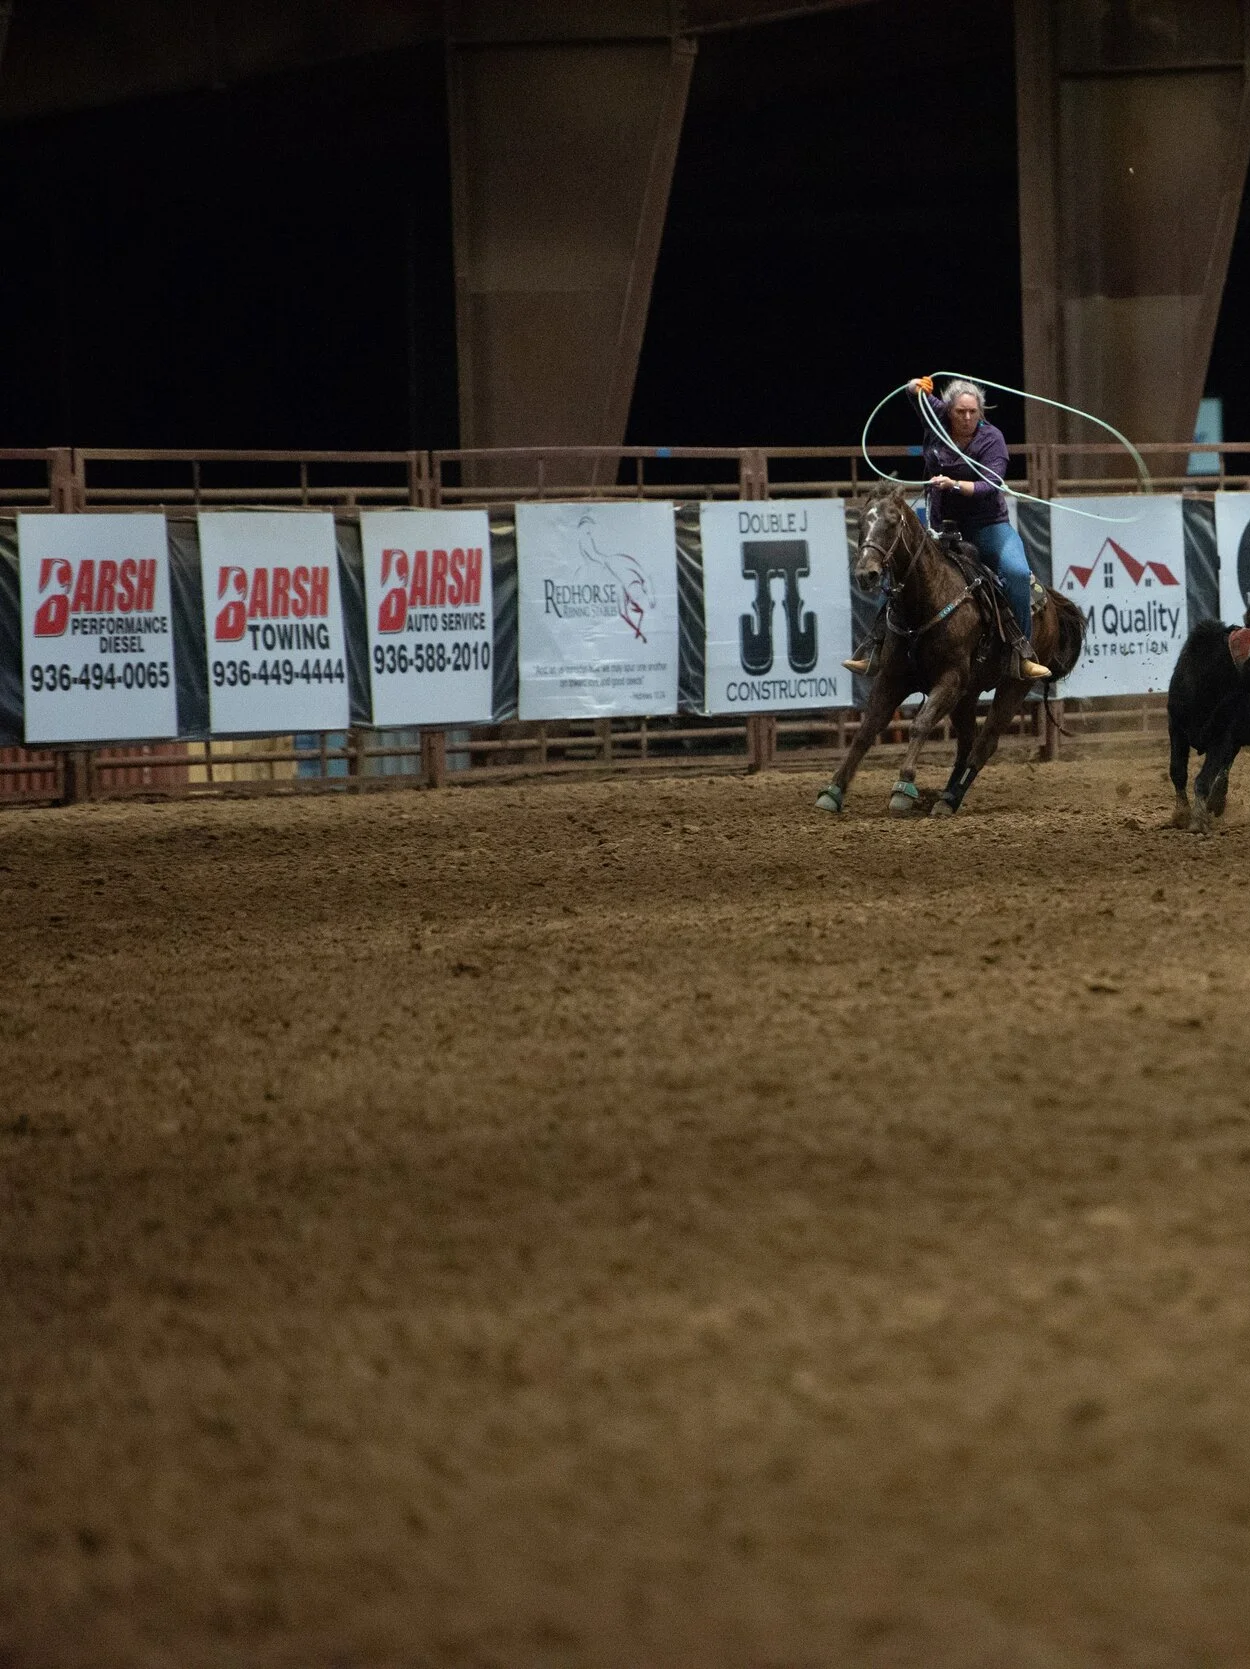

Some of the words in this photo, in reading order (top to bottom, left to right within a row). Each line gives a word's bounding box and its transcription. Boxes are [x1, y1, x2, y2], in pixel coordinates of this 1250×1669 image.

[739, 512, 796, 534] DOUBLE
[800, 511, 807, 532] J
[71, 616, 168, 635] PERFORMANCE
[406, 614, 439, 633] AUTO
[442, 611, 486, 631] SERVICE
[1102, 600, 1180, 638] Quality
[99, 636, 145, 653] DIESEL
[247, 623, 331, 651] TOWING
[1084, 641, 1168, 656] NSTRUCTION
[374, 642, 490, 674] 936-588-2010
[30, 662, 170, 692] 936-494-0065
[213, 658, 345, 687] 936-449-4444
[726, 676, 838, 702] CONSTRUCTION
